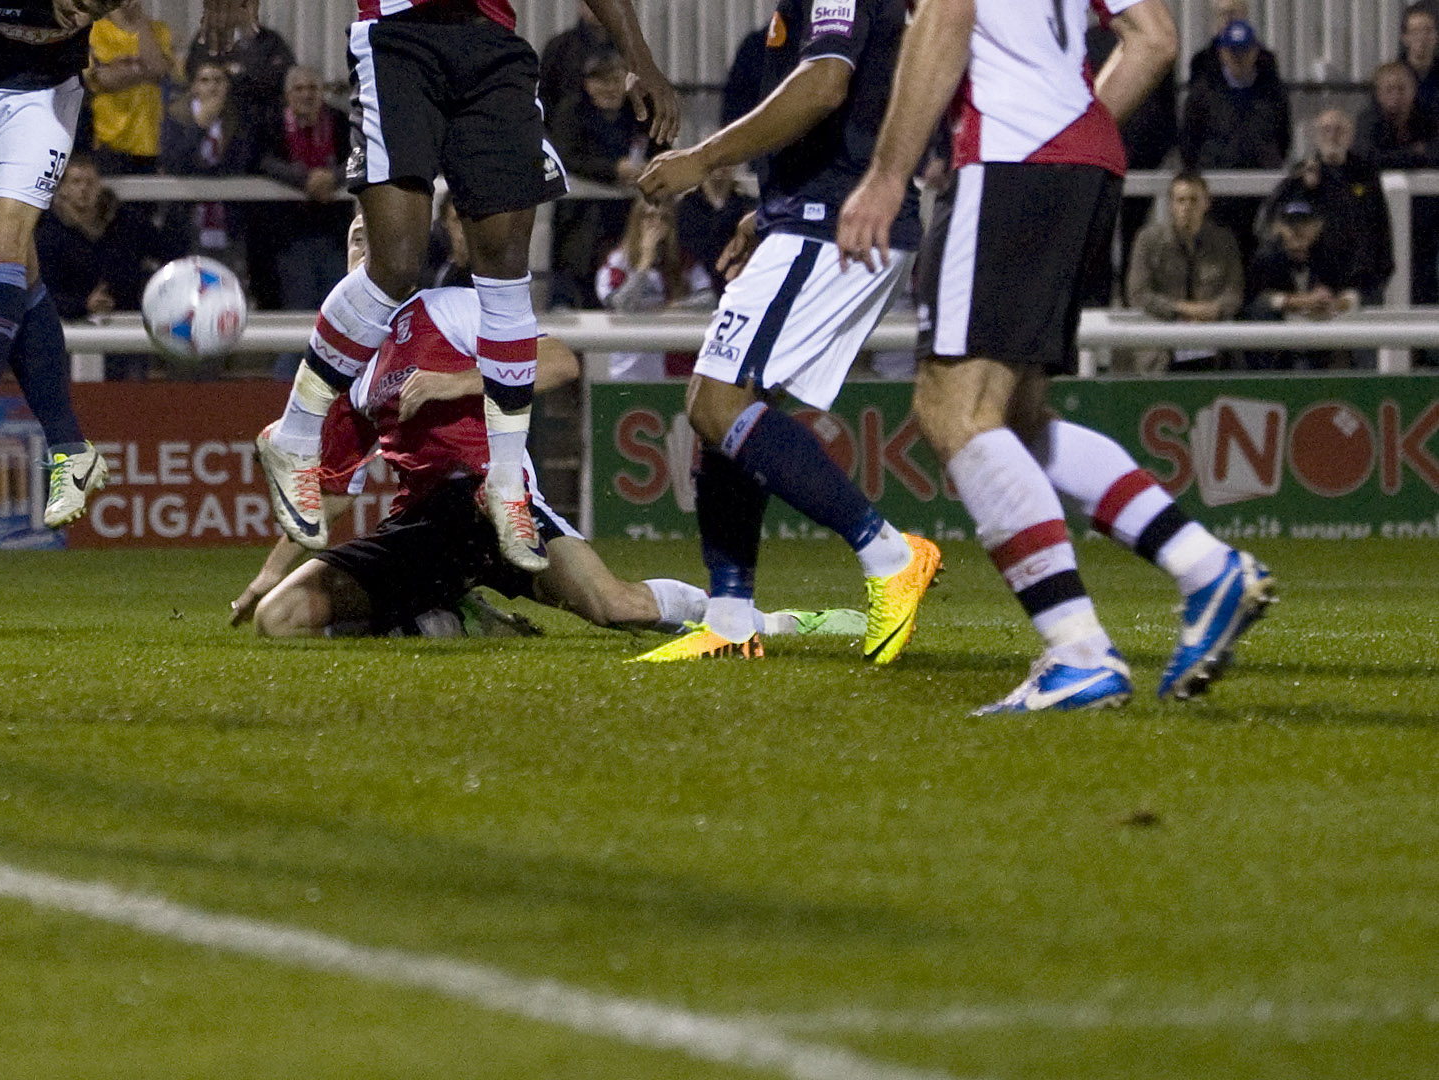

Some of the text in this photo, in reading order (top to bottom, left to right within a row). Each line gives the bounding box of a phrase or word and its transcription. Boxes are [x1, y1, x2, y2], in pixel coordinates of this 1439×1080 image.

[814, 6, 851, 19] Skrill
[715, 310, 750, 343] 27
[707, 343, 735, 361] FILA
